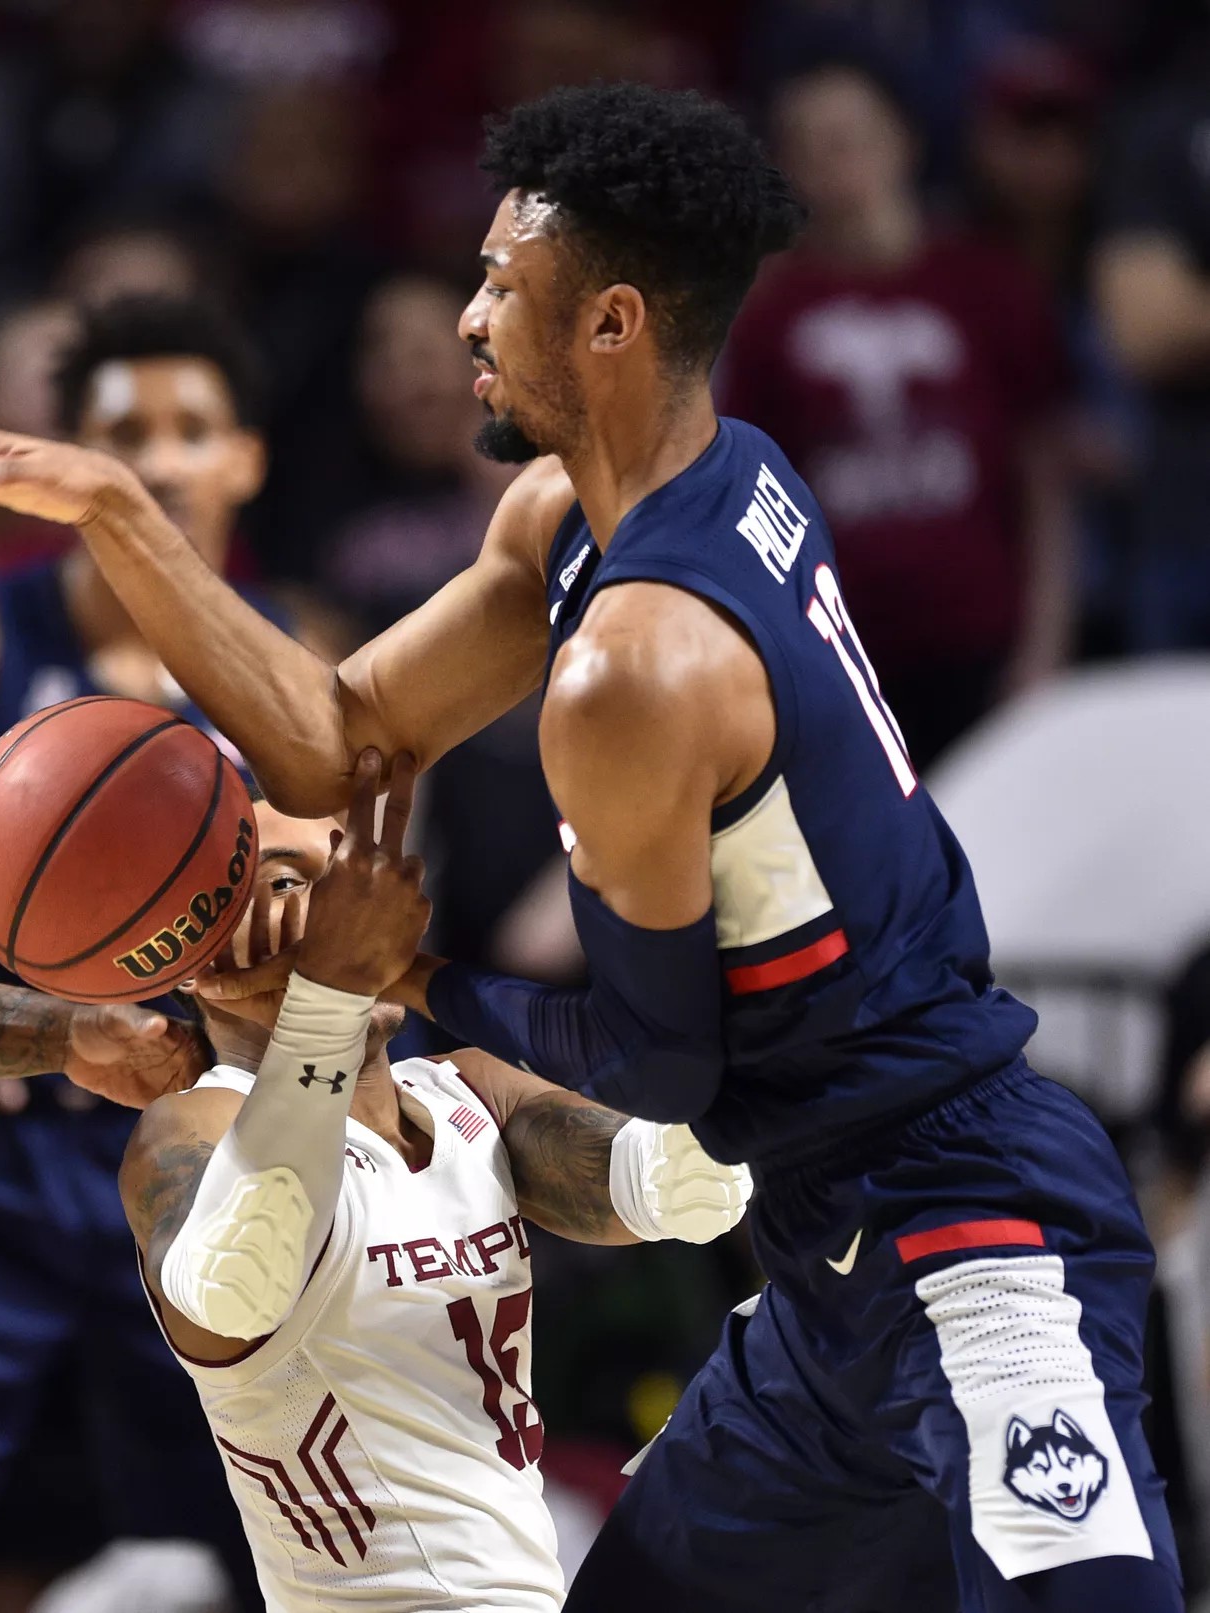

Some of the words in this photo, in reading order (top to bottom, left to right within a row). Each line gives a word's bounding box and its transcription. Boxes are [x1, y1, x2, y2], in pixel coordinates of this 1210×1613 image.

[736, 462, 809, 584] POLLEY
[113, 816, 253, 980] Wilson
[446, 1287, 545, 1471] 15
